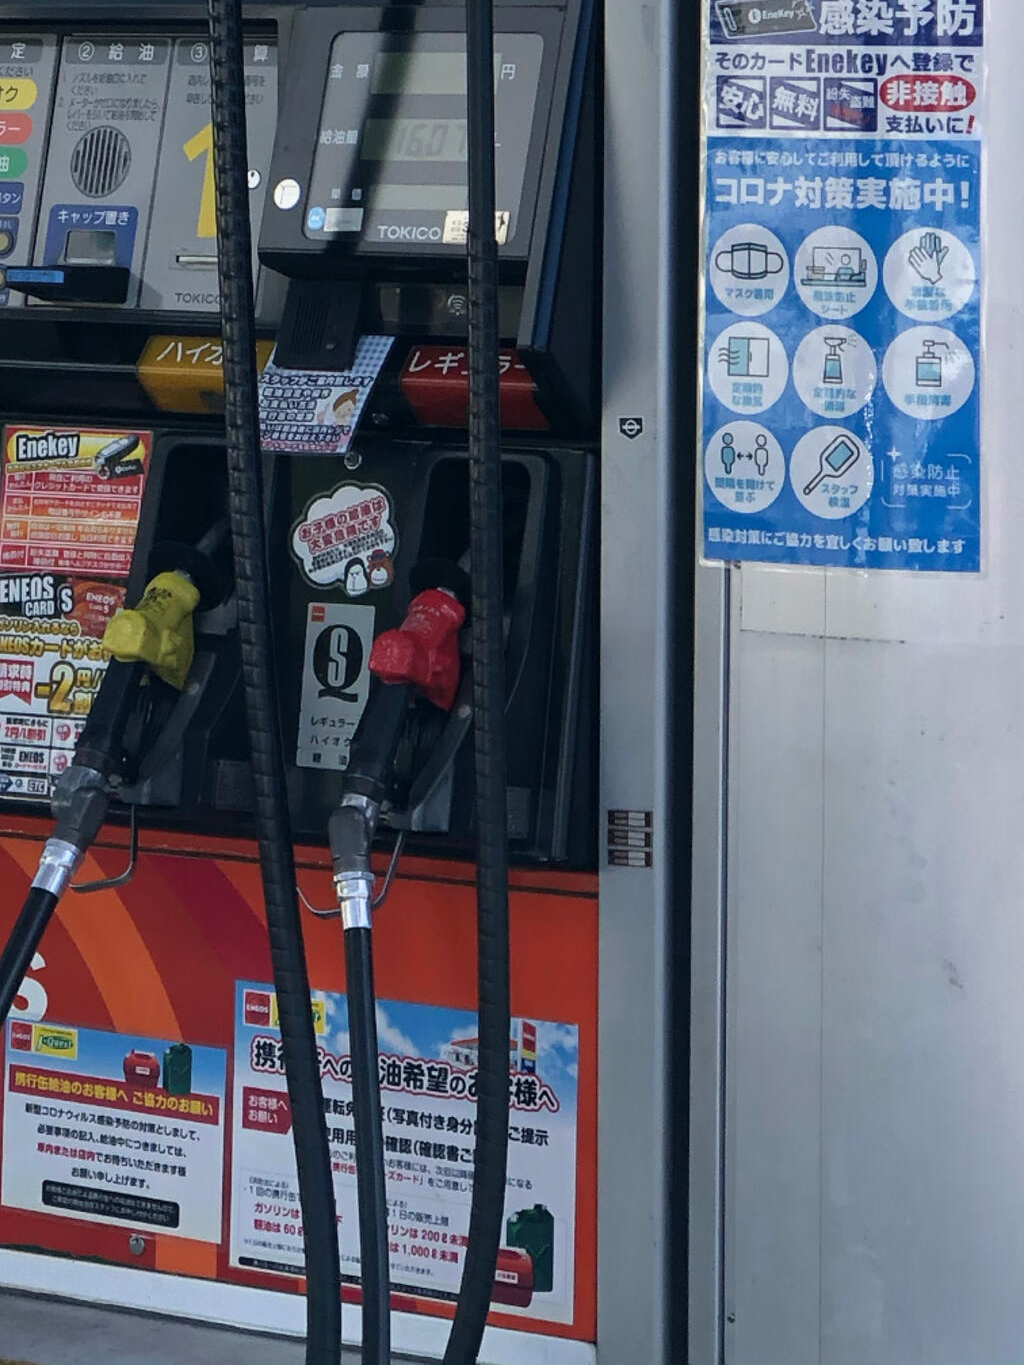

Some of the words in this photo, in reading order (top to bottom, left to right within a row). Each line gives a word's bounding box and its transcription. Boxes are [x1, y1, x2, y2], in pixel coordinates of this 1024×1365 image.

[715, 49, 975, 75] そのカードEnekeyへ登録で
[501, 64, 516, 80] 円
[887, 80, 968, 107] 非接触
[721, 85, 765, 121] 安心
[772, 86, 820, 122] 無料
[319, 129, 359, 145] 給油量
[715, 176, 971, 212] コロナ対策実施中!
[58, 209, 130, 226] キャップ置き
[378, 225, 442, 240] TOKICO
[408, 350, 526, 375] レギラー
[17, 435, 78, 460] Enekey
[893, 464, 961, 481] 感染防止
[0, 576, 54, 603] ENEOS
[25, 600, 55, 617] CARD
[310, 716, 356, 728] レギュラー
[310, 735, 352, 747] ハイオク
[14, 1070, 128, 1103] 携行缶給油のお客様へ
[132, 1090, 214, 1117] ご協力のお願い
[247, 1095, 289, 1111] お客様へ
[247, 1110, 278, 1125] お願い
[71, 1166, 151, 1190] お願い申し上げます。
[254, 1201, 301, 1219] ガソリンは
